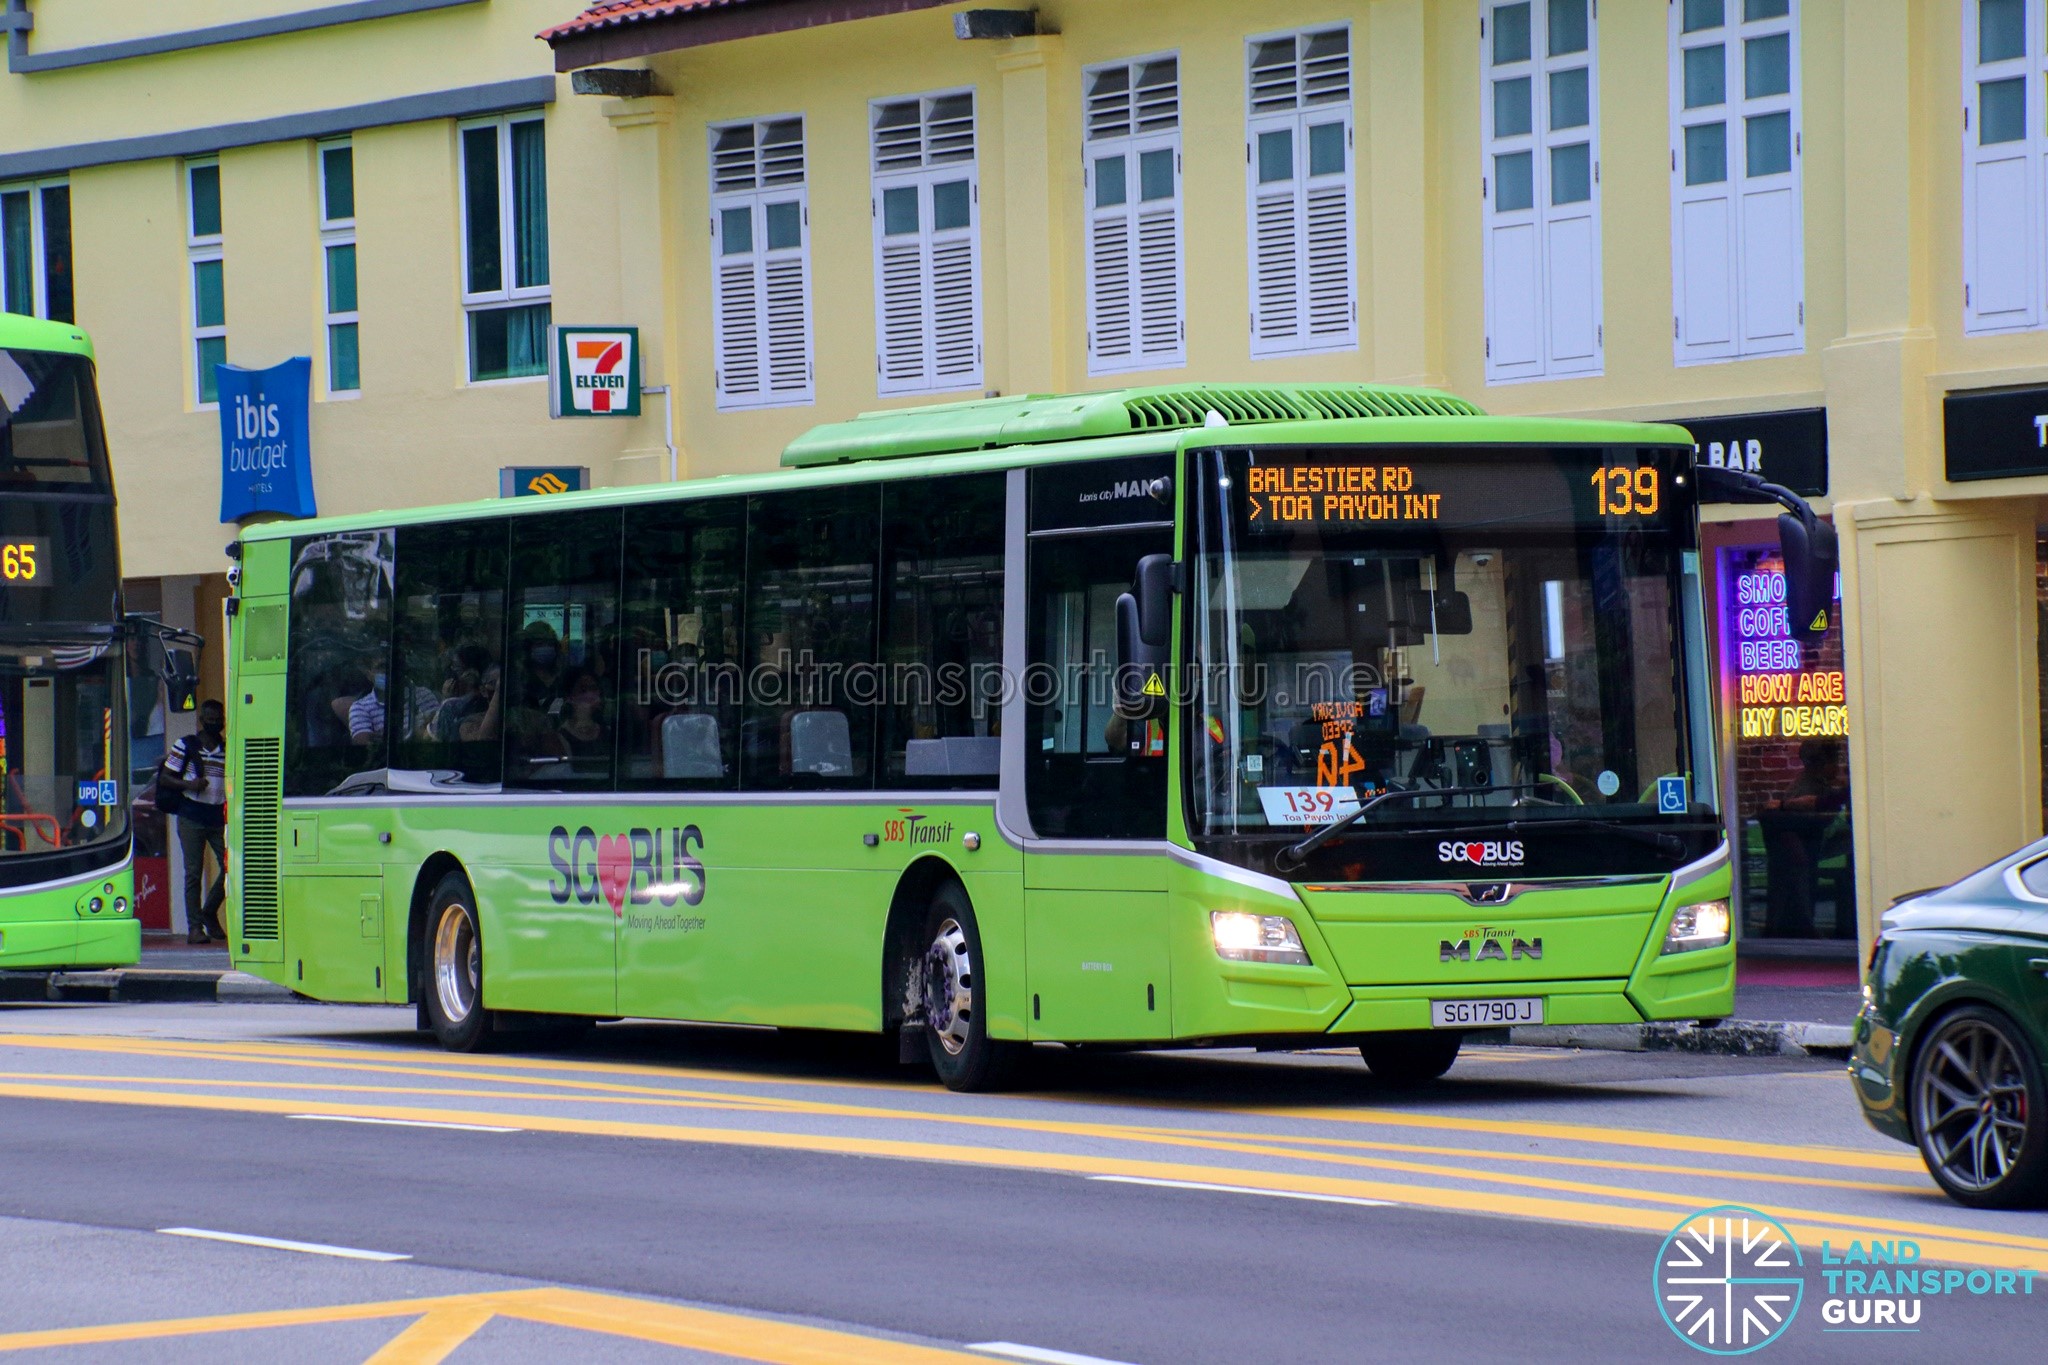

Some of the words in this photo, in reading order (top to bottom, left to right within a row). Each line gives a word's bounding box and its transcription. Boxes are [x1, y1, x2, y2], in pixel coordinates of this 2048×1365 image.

[576, 341, 622, 411] 7
[236, 393, 280, 440] ibis
[230, 440, 288, 477] budget
[1708, 439, 1762, 472] BAR
[1099, 490, 1114, 501] City
[1114, 479, 1156, 499] MAN
[1249, 467, 1376, 493] BALESTIER
[1382, 467, 1412, 492] RD
[1591, 467, 1658, 515] 139
[1268, 495, 1313, 520] TOA
[1324, 495, 1398, 520] PAYOH
[1403, 494, 1441, 519] INT
[3, 544, 36, 580] 65
[1739, 573, 1787, 604] SMO
[1741, 640, 1799, 671] BEER
[1741, 673, 1793, 704] HOW
[1797, 671, 1844, 703] ARE
[1742, 707, 1776, 737] MY
[79, 785, 98, 800] UPD
[1284, 791, 1334, 812] 139
[884, 820, 905, 842] SBS
[905, 815, 955, 848] Transit
[1283, 814, 1301, 822] Toa
[1304, 813, 1334, 823] Payoh
[628, 914, 652, 933] Moving
[653, 914, 676, 930] Ahead
[677, 914, 706, 933] Together
[1463, 929, 1480, 939] SBS
[1480, 926, 1515, 939] Transit
[1440, 938, 1543, 962] MAN
[1444, 1002, 1532, 1022] SG1790J
